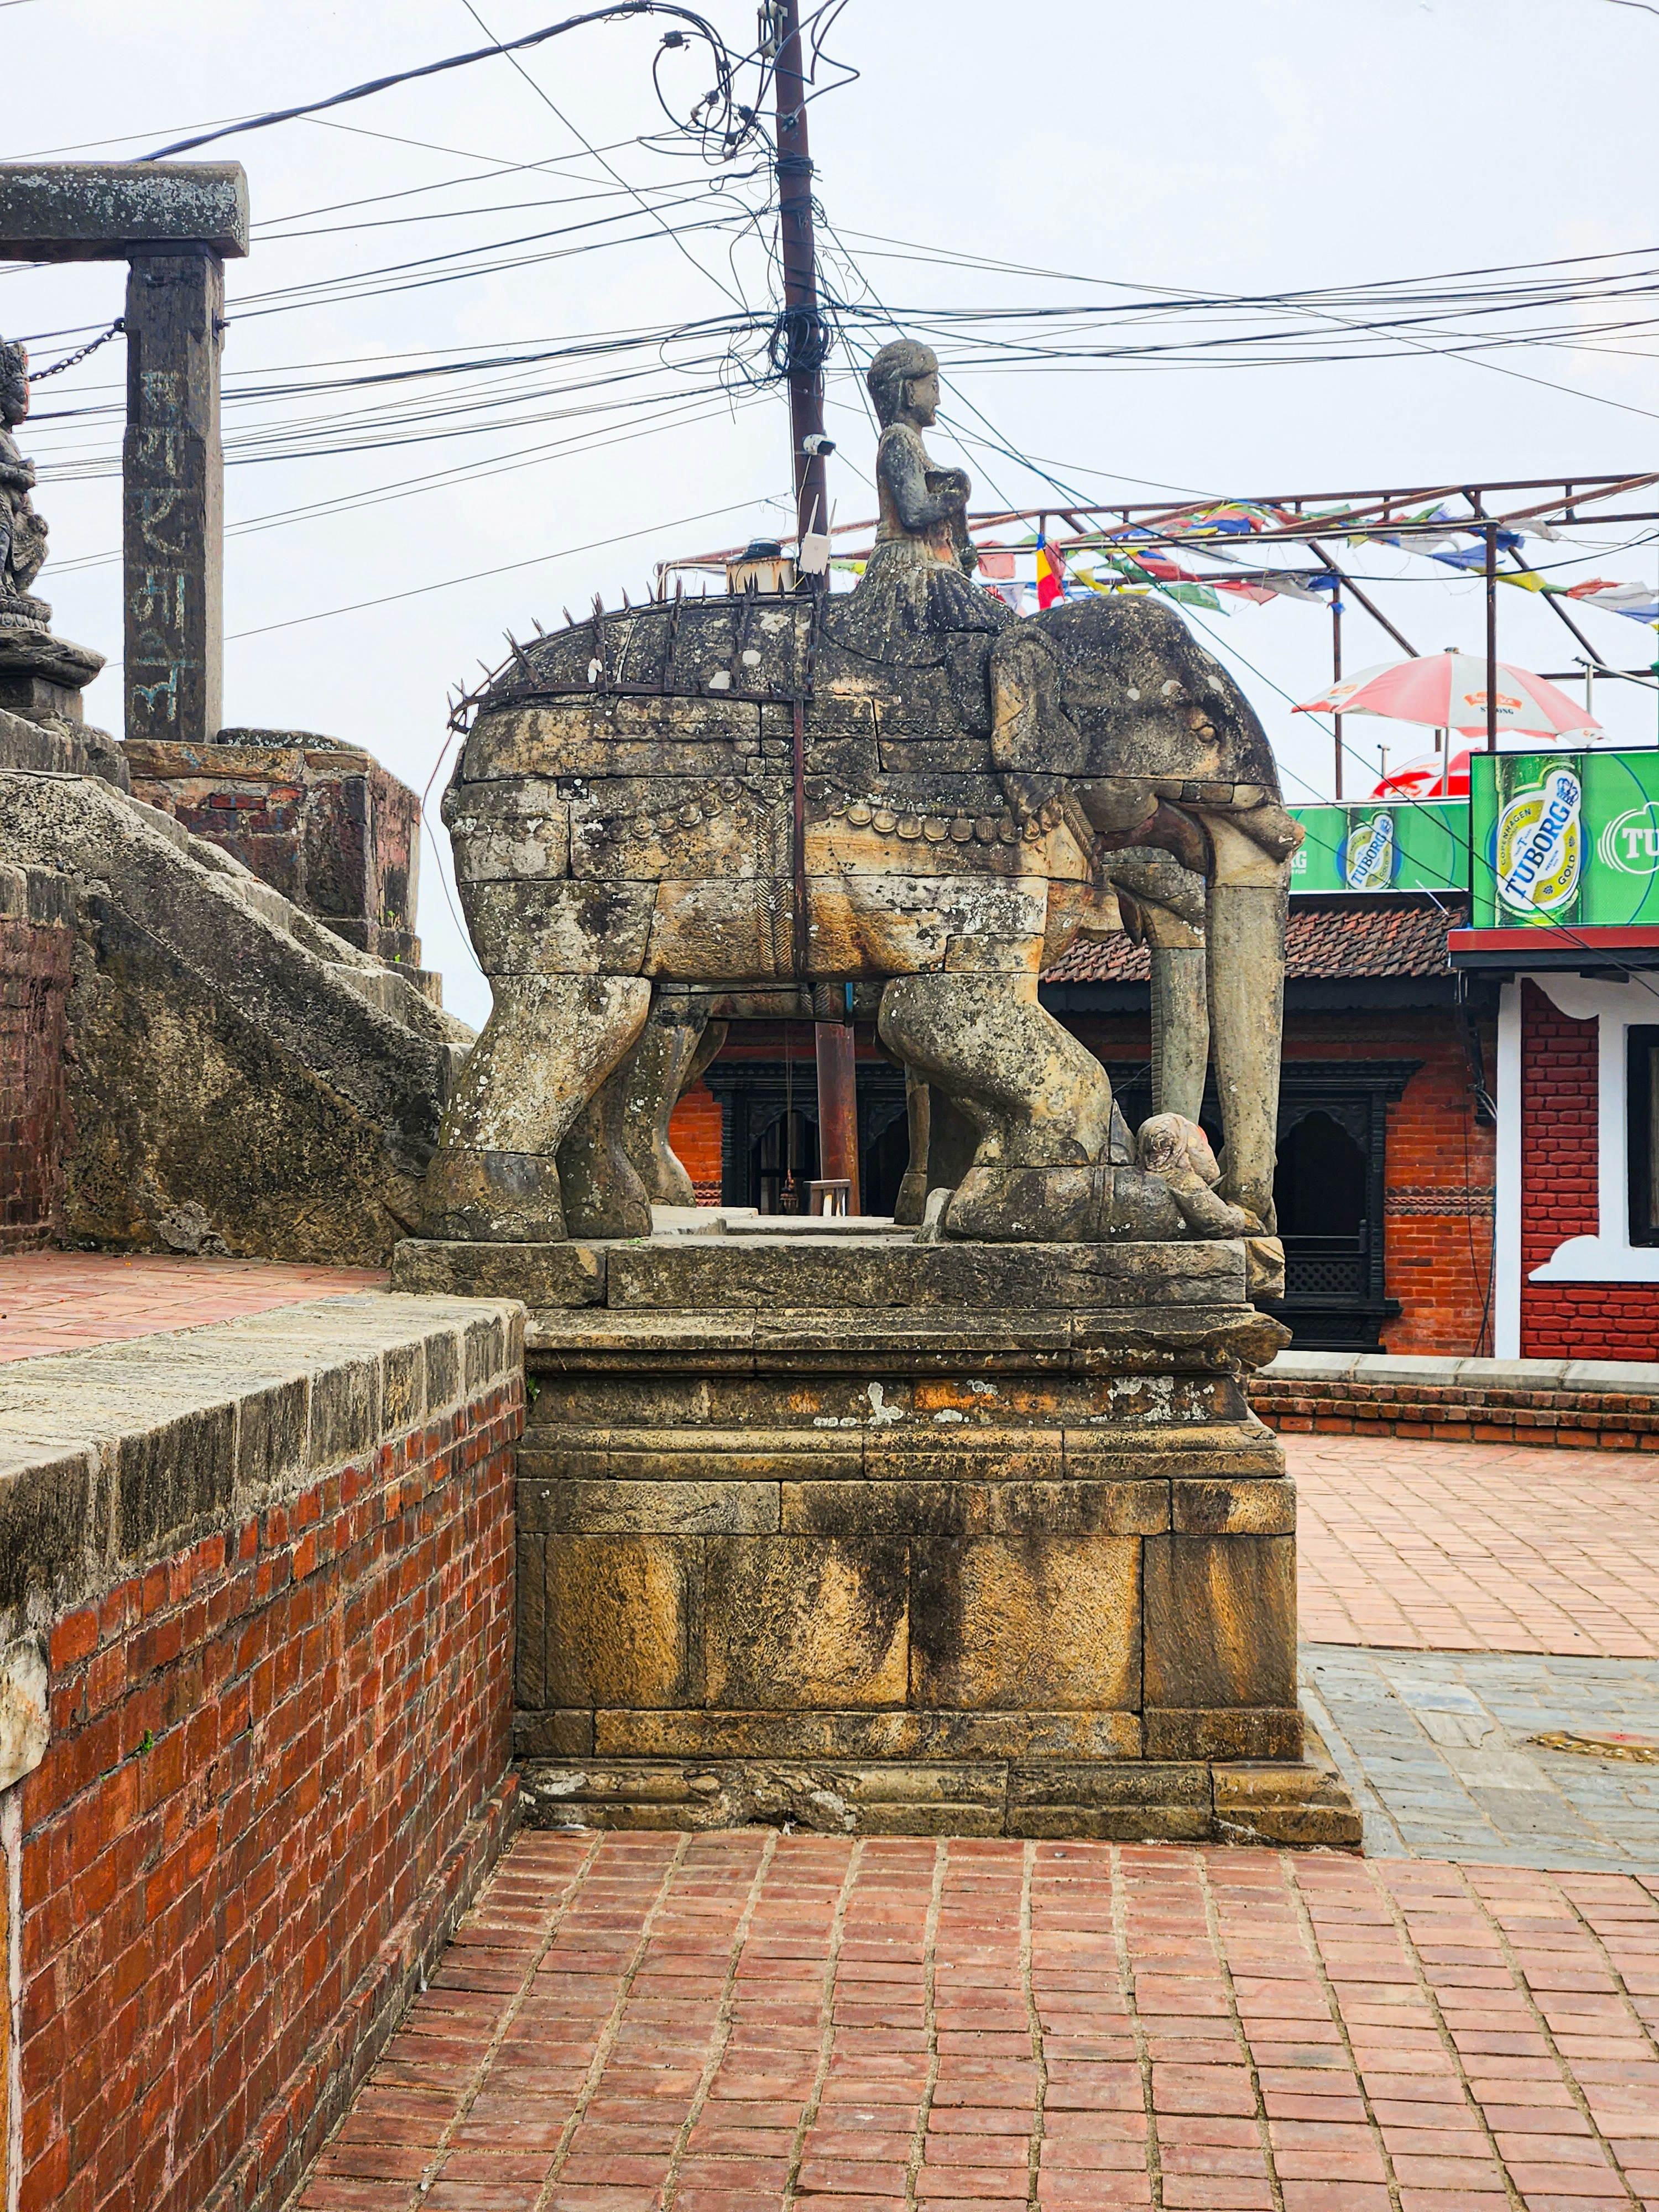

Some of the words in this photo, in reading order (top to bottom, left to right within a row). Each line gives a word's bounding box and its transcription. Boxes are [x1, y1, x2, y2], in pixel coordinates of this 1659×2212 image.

[1351, 832, 1386, 884] TUBORG
[1500, 808, 1531, 865] COPENHAGEN
[1505, 800, 1571, 899] TUBORG
[1558, 854, 1575, 885] GOLD
